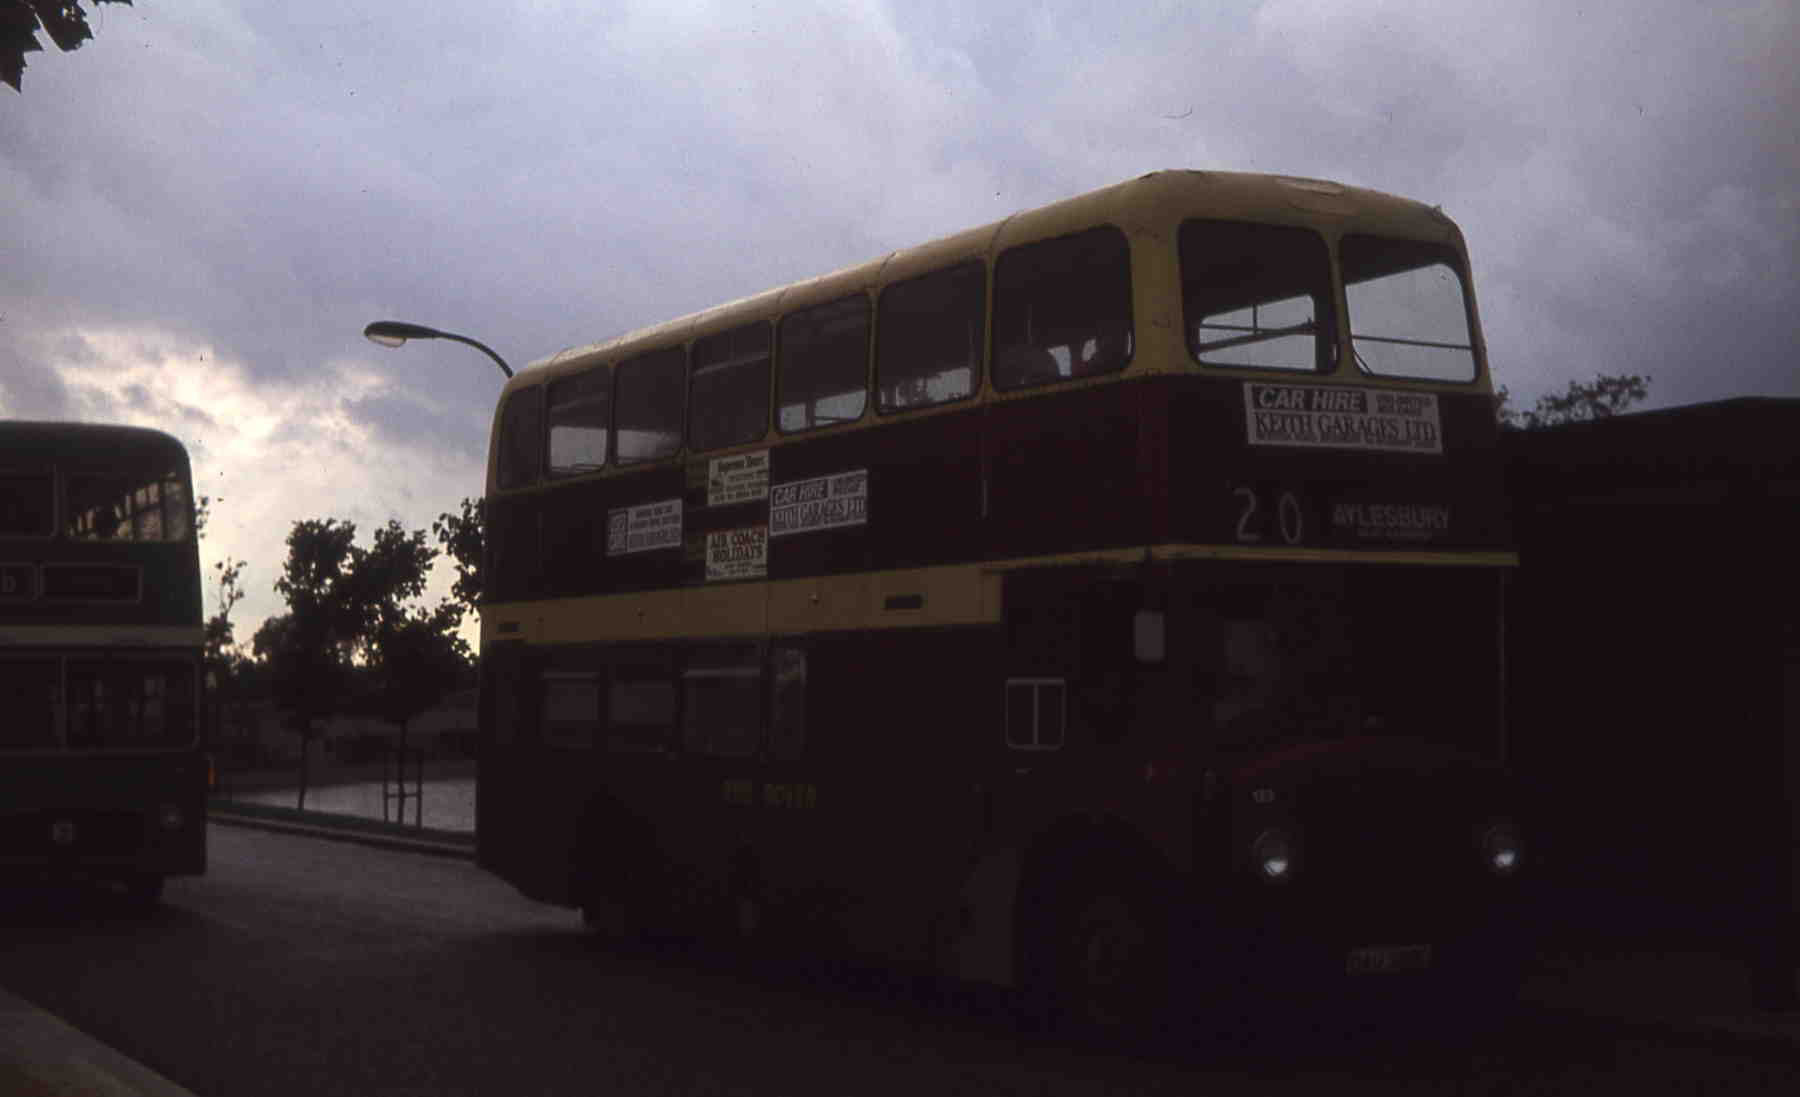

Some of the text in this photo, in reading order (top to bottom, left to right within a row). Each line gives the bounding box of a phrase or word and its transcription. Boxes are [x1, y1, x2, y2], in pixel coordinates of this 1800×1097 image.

[1258, 388, 1305, 409] CAR
[1311, 390, 1361, 411] HIRE
[1255, 412, 1312, 434] KEITH
[775, 487, 797, 505] CAR
[1331, 504, 1449, 529] AYLESBURY
[711, 543, 764, 563] HOLIDAYS
